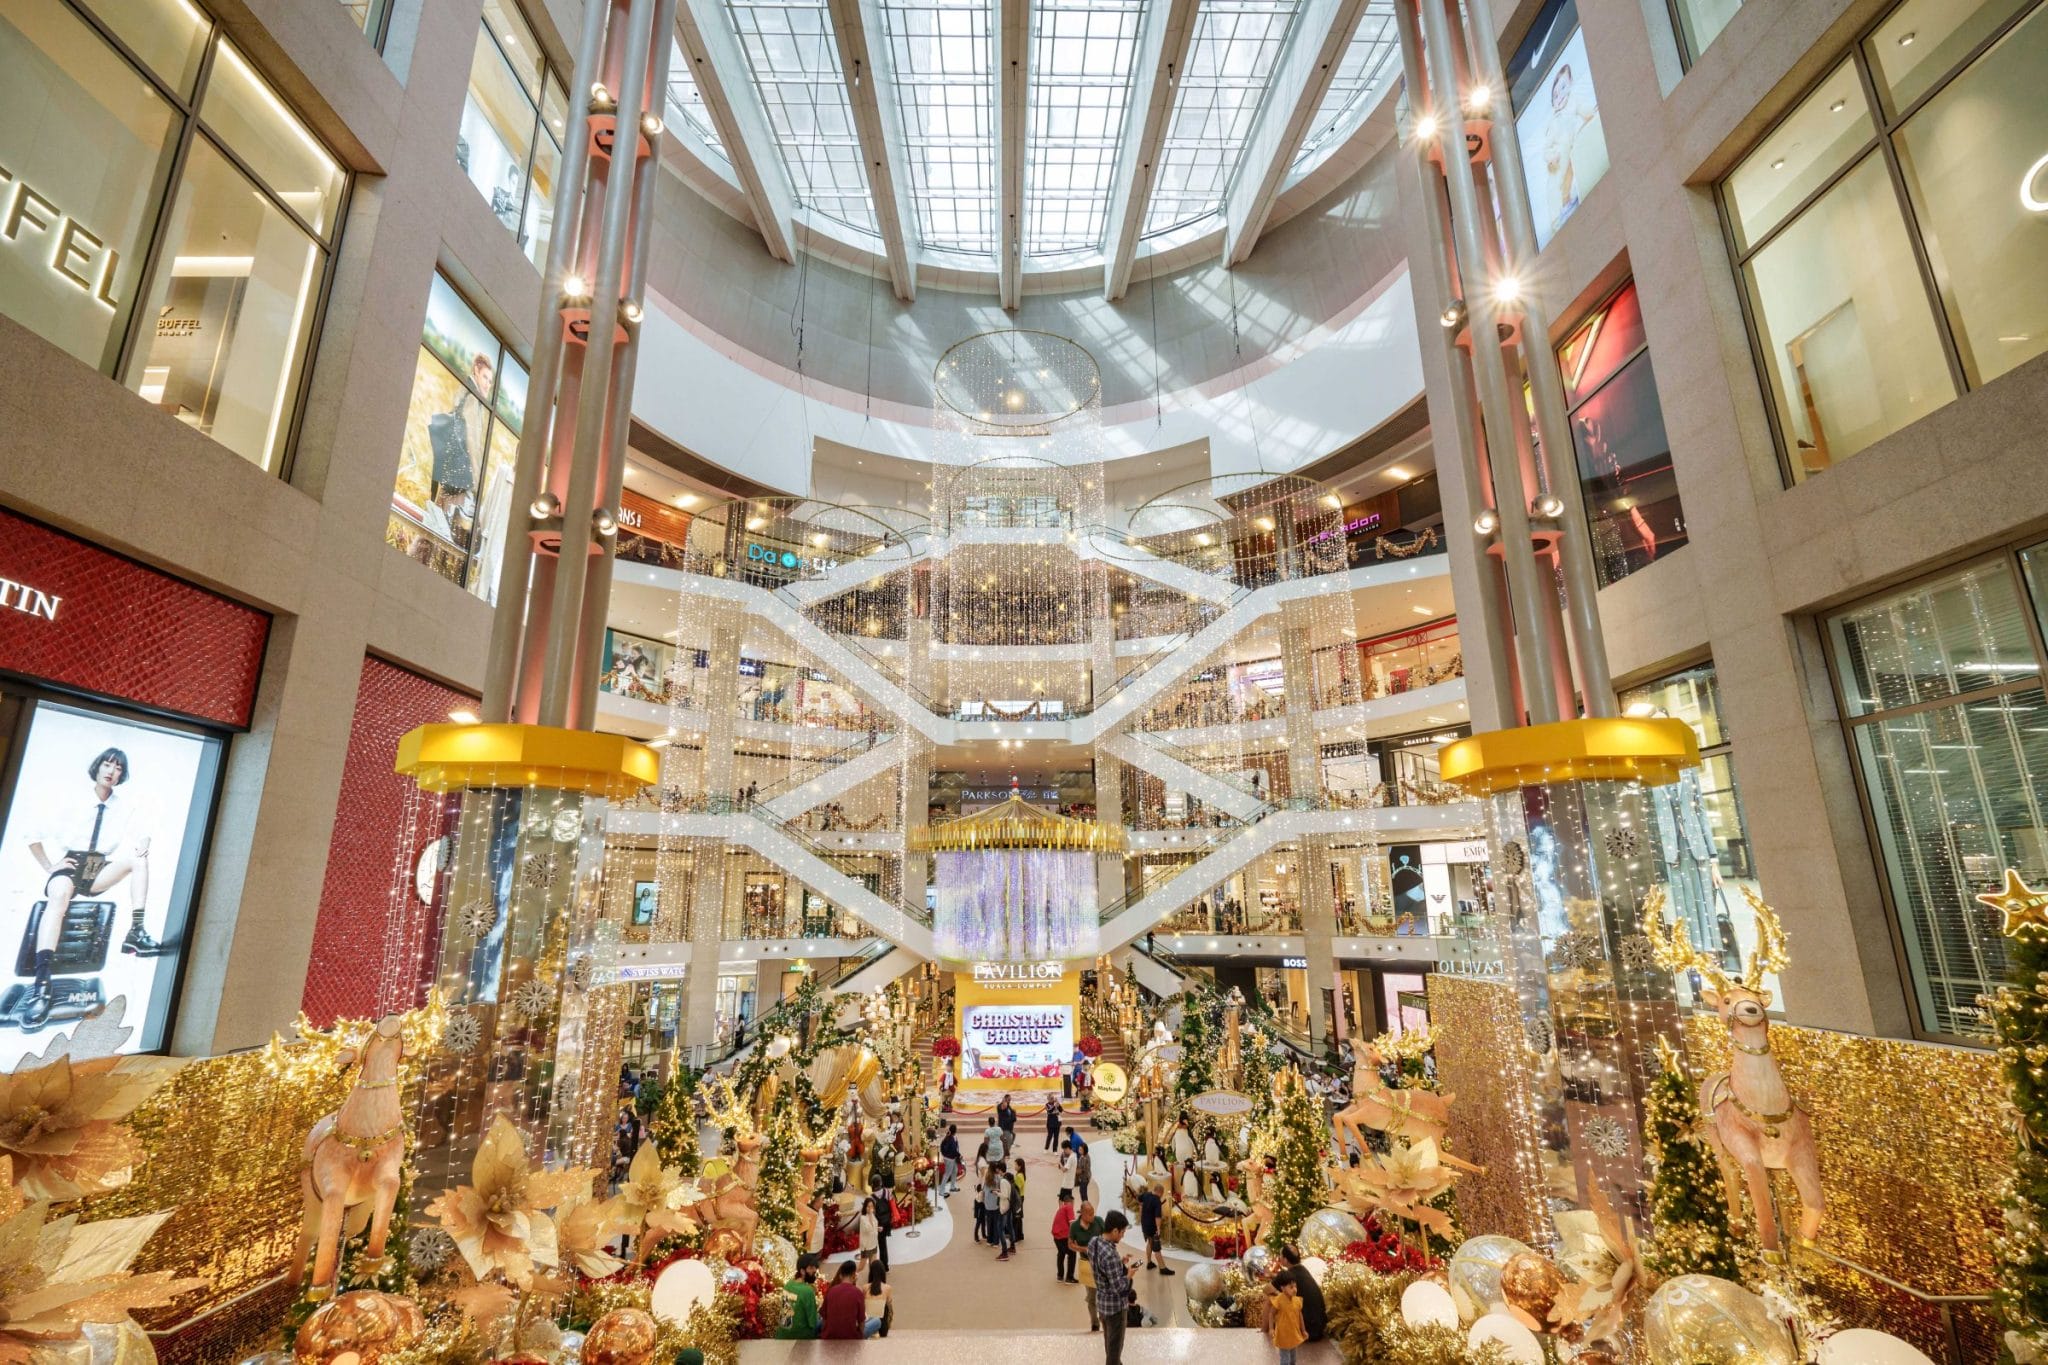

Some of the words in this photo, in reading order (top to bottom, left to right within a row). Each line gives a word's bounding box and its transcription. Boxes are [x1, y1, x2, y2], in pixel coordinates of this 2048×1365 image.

[0, 165, 120, 312] FEL
[1283, 958, 1307, 968] BOSS
[632, 968, 659, 977] SWISS
[973, 964, 1064, 979] PAVILION
[971, 1012, 1065, 1030] CHRISTMAS
[984, 1028, 1053, 1046] CHORUS
[1199, 1096, 1246, 1106] PAVILION
